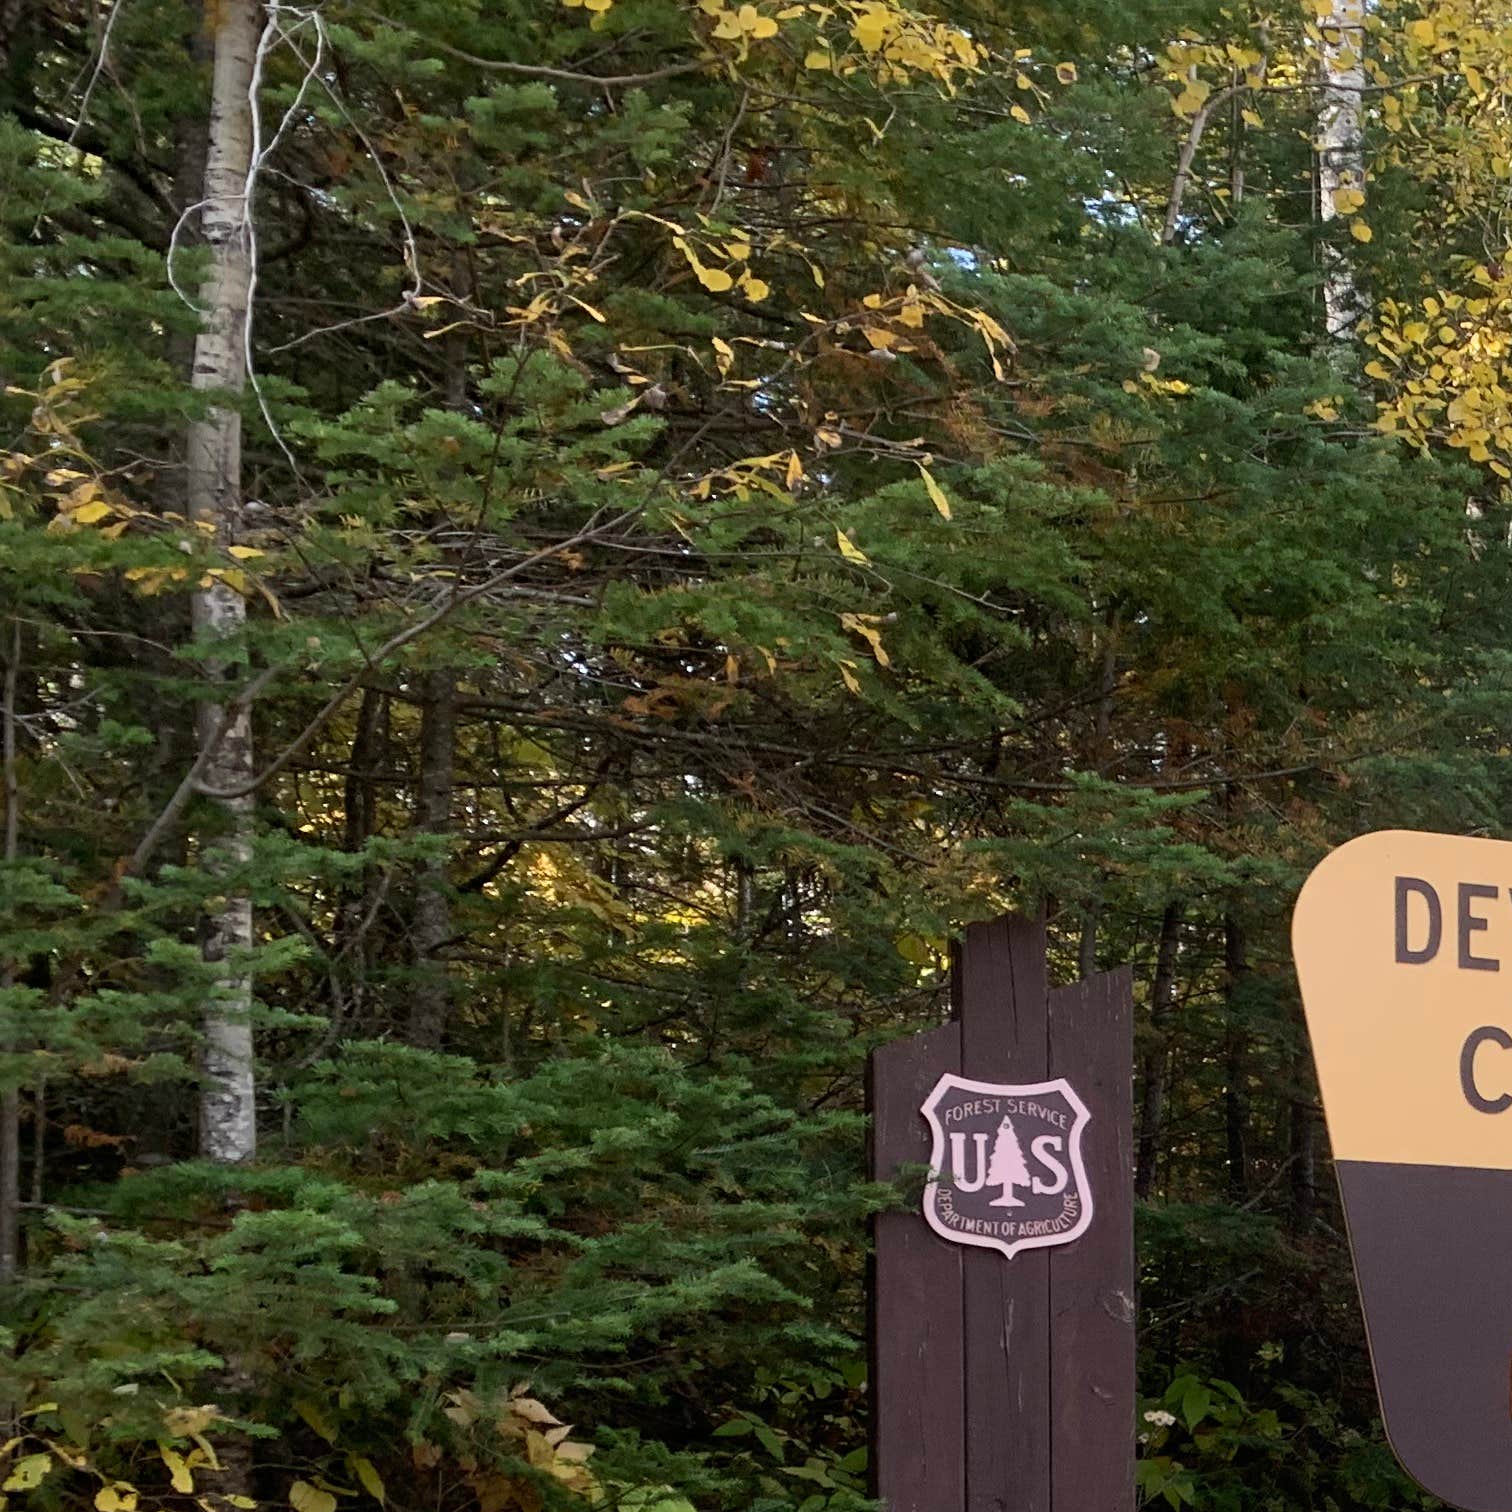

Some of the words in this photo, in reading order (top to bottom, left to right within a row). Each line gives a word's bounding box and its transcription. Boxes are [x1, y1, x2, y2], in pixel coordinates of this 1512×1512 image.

[944, 1099, 1001, 1126] FOREST
[1007, 1099, 1068, 1130] SERVICE
[937, 1188, 1000, 1235] DEPARTMENT
[1001, 1220, 1016, 1236] OF
[1018, 1191, 1079, 1236] AGRICULTURE
